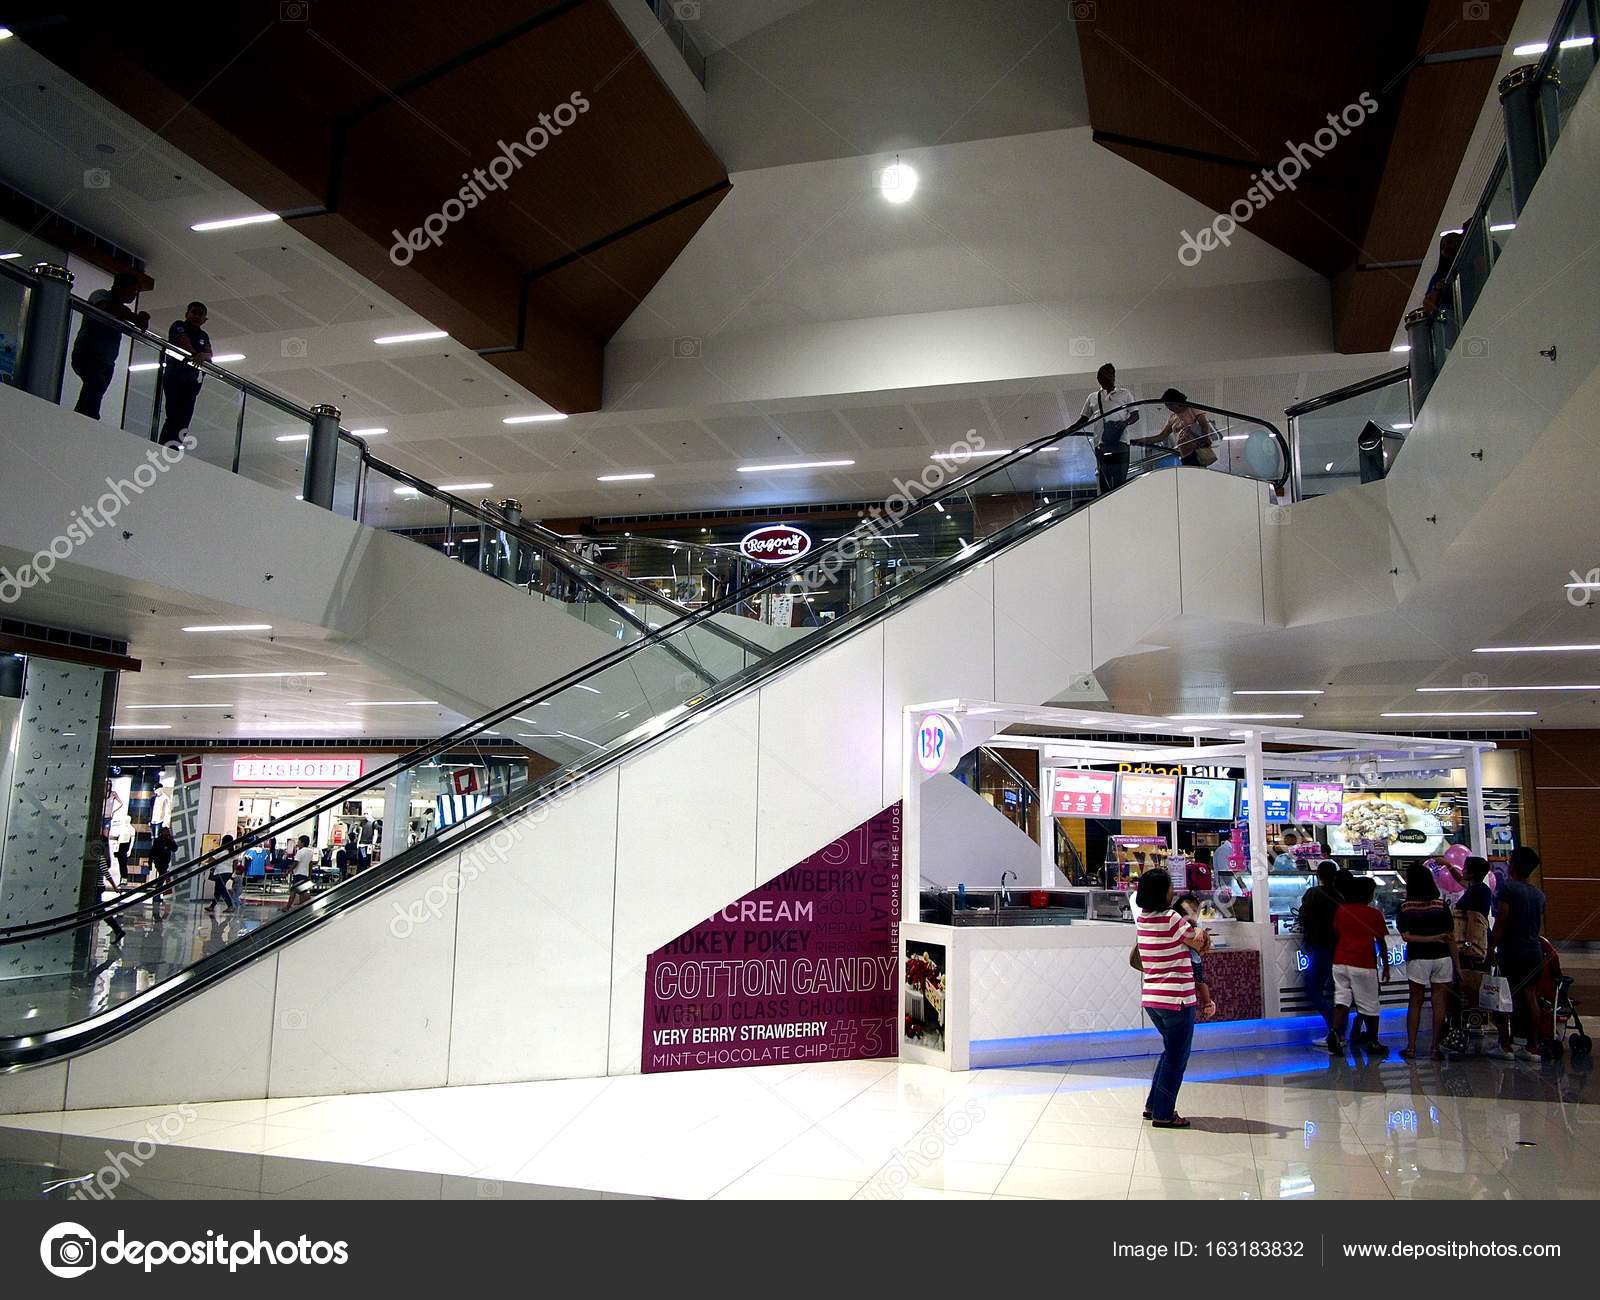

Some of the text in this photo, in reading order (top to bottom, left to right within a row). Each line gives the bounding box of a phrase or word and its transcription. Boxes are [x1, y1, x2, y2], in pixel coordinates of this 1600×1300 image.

[891, 845, 899, 869] THE
[816, 899, 867, 915] GOLD
[891, 873, 899, 916] COMES
[722, 900, 813, 922] CREAM
[743, 929, 811, 953] POKEY
[891, 921, 899, 953] HERE
[654, 956, 898, 1000] COTTON CANDY
[654, 994, 898, 1024] WORLD CLASS CHOCOLATE
[653, 1021, 828, 1046] VERY BERRY STRAWBERRY
[828, 1017, 898, 1059] #31
[652, 1043, 828, 1067] MINT CHOCOLATE CHIP
